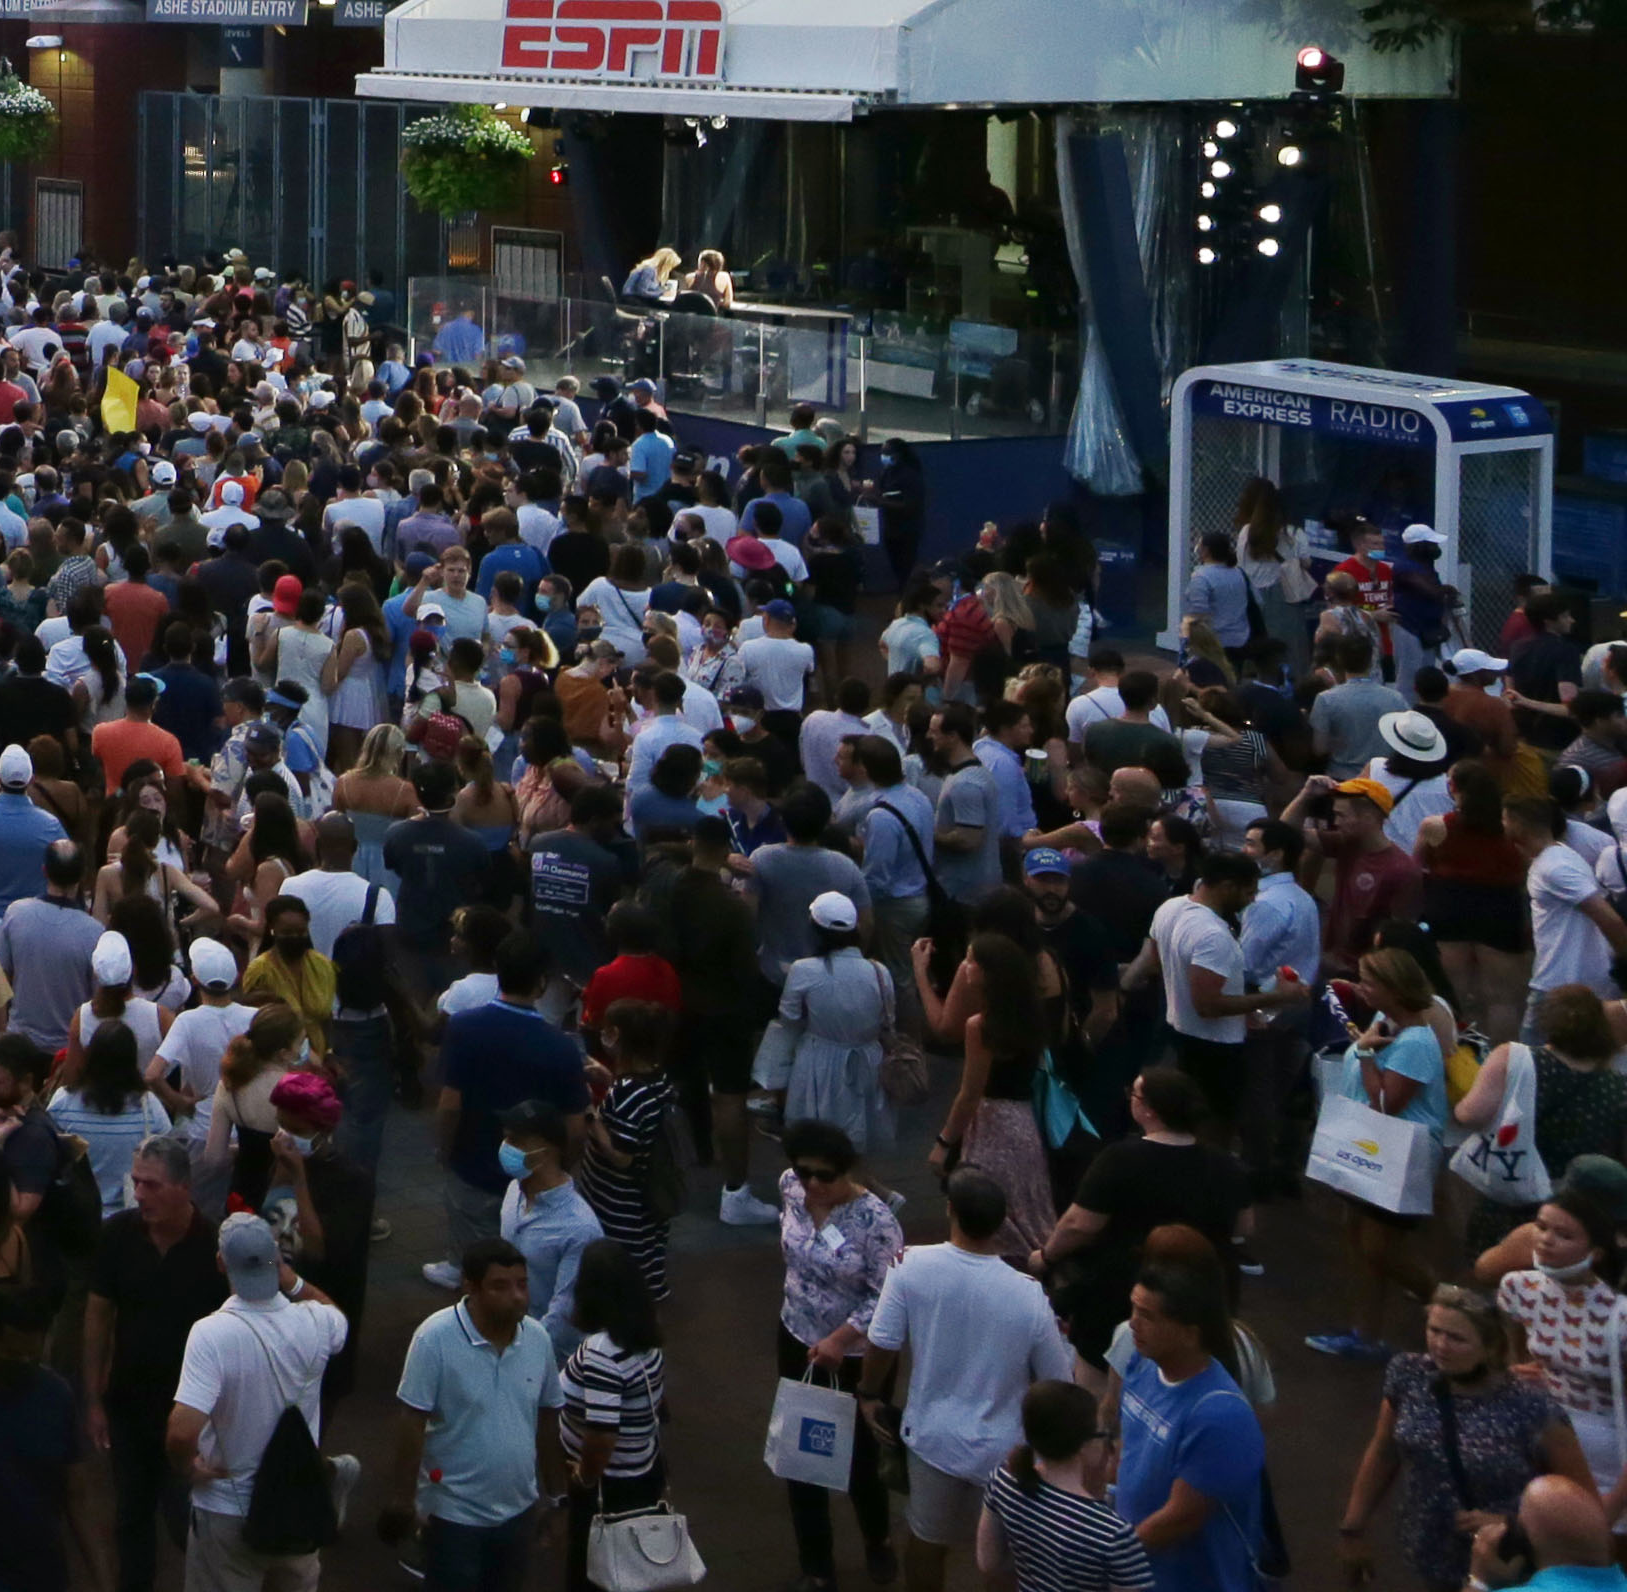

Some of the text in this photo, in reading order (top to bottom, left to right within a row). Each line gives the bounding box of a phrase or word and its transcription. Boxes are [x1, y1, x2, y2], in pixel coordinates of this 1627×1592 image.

[155, 0, 297, 17] ASHE STADIUM ENTRY
[344, 2, 383, 18] ASHE
[1210, 383, 1420, 433] AMERICAN RADIO
[1223, 400, 1312, 426] EXPRESS
[1336, 1149, 1383, 1172] us open
